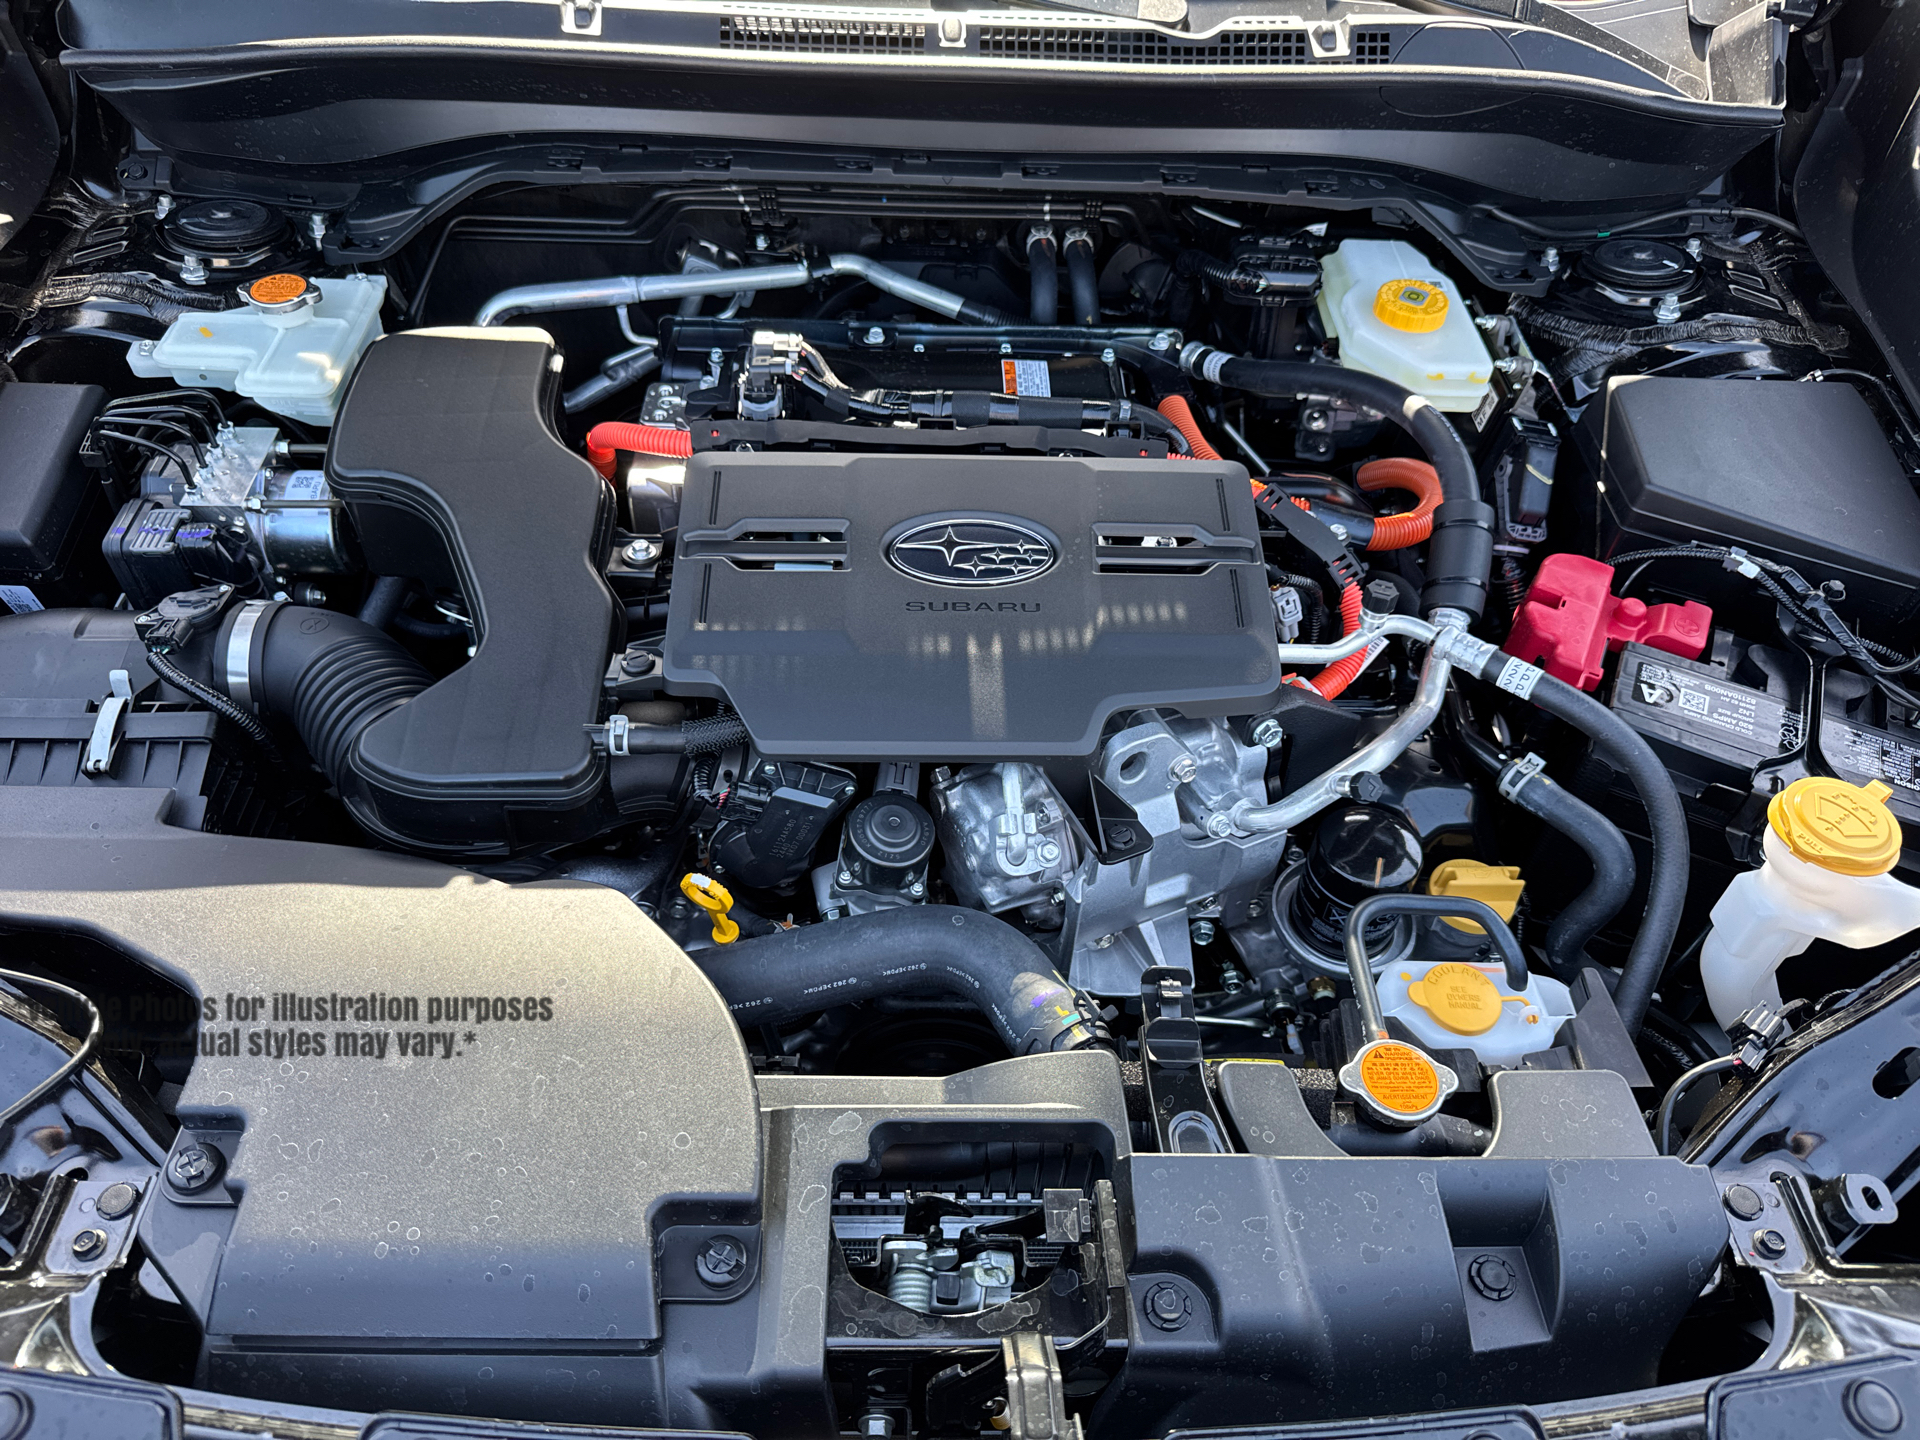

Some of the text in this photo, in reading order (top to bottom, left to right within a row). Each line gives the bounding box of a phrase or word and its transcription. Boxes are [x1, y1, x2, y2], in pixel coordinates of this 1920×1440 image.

[905, 601, 1041, 613] SUBARU
[1717, 707, 1755, 723] GROUP SIZE
[1738, 707, 1755, 717] LN2
[1683, 709, 1753, 735] COLD CRANKING AMPS
[1712, 712, 1754, 730] 620 AMPS
[1894, 779, 1920, 790] OISON
[1428, 965, 1491, 986] COOLANT
[833, 980, 847, 988] 262
[1446, 993, 1481, 1001] OWNERS
[745, 999, 762, 1007] 262
[1448, 1001, 1483, 1010] MANUAL
